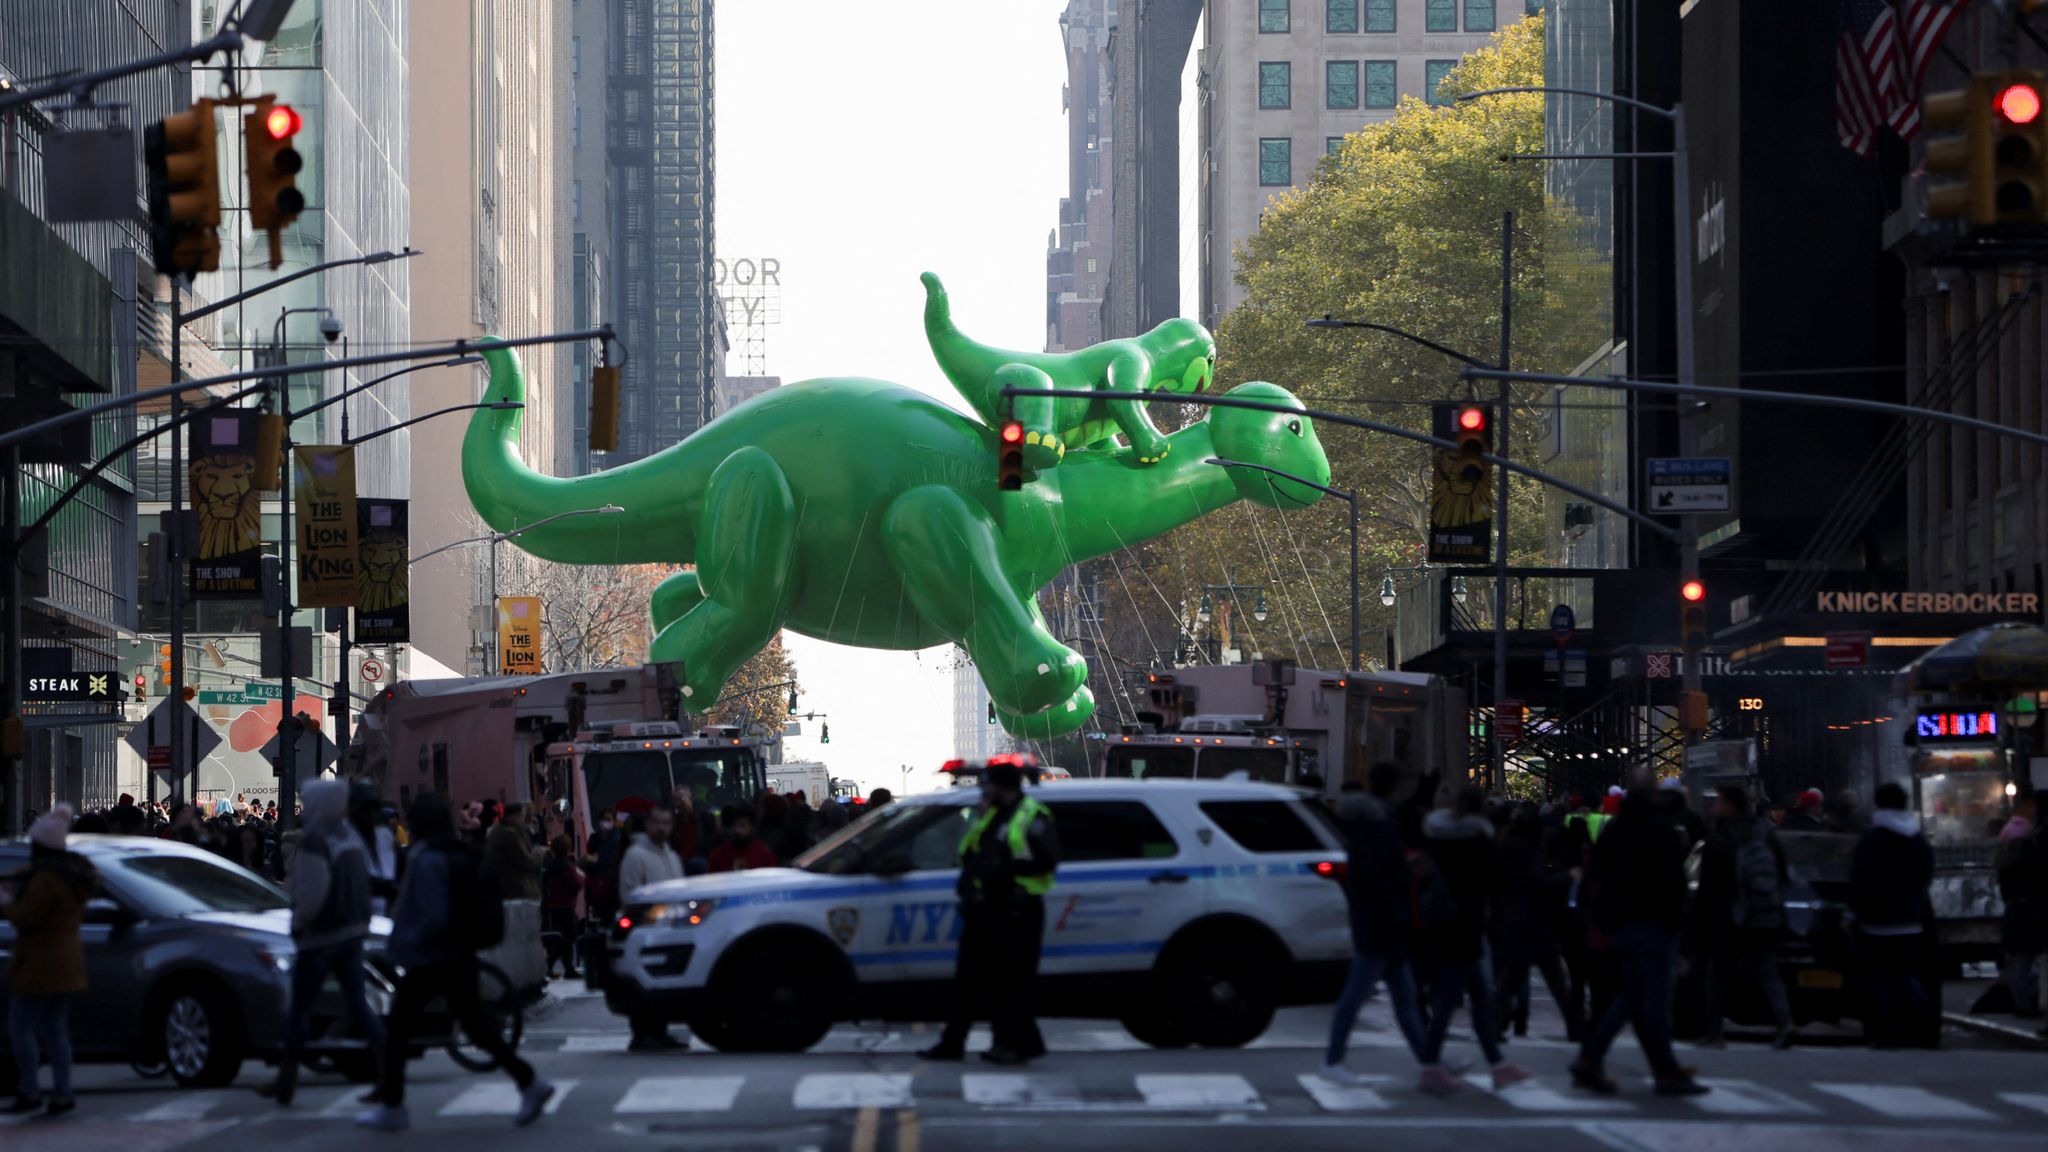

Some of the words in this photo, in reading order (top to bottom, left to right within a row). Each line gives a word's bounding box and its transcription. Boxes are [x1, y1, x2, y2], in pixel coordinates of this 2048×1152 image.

[310, 502, 342, 517] THE
[305, 525, 347, 549] LION
[196, 567, 213, 579] THE
[215, 567, 241, 579] SHOW
[301, 554, 353, 582] KING
[1817, 591, 2039, 613] KNICKERBOCKER
[374, 618, 394, 628] SHOW
[510, 635, 530, 645] THE
[506, 649, 534, 666] LION
[29, 678, 79, 691] STEAK
[216, 693, 224, 702] W
[226, 693, 237, 703] 42
[265, 687, 273, 697] 42
[1738, 698, 1763, 711] 130
[242, 787, 268, 795] 14,000
